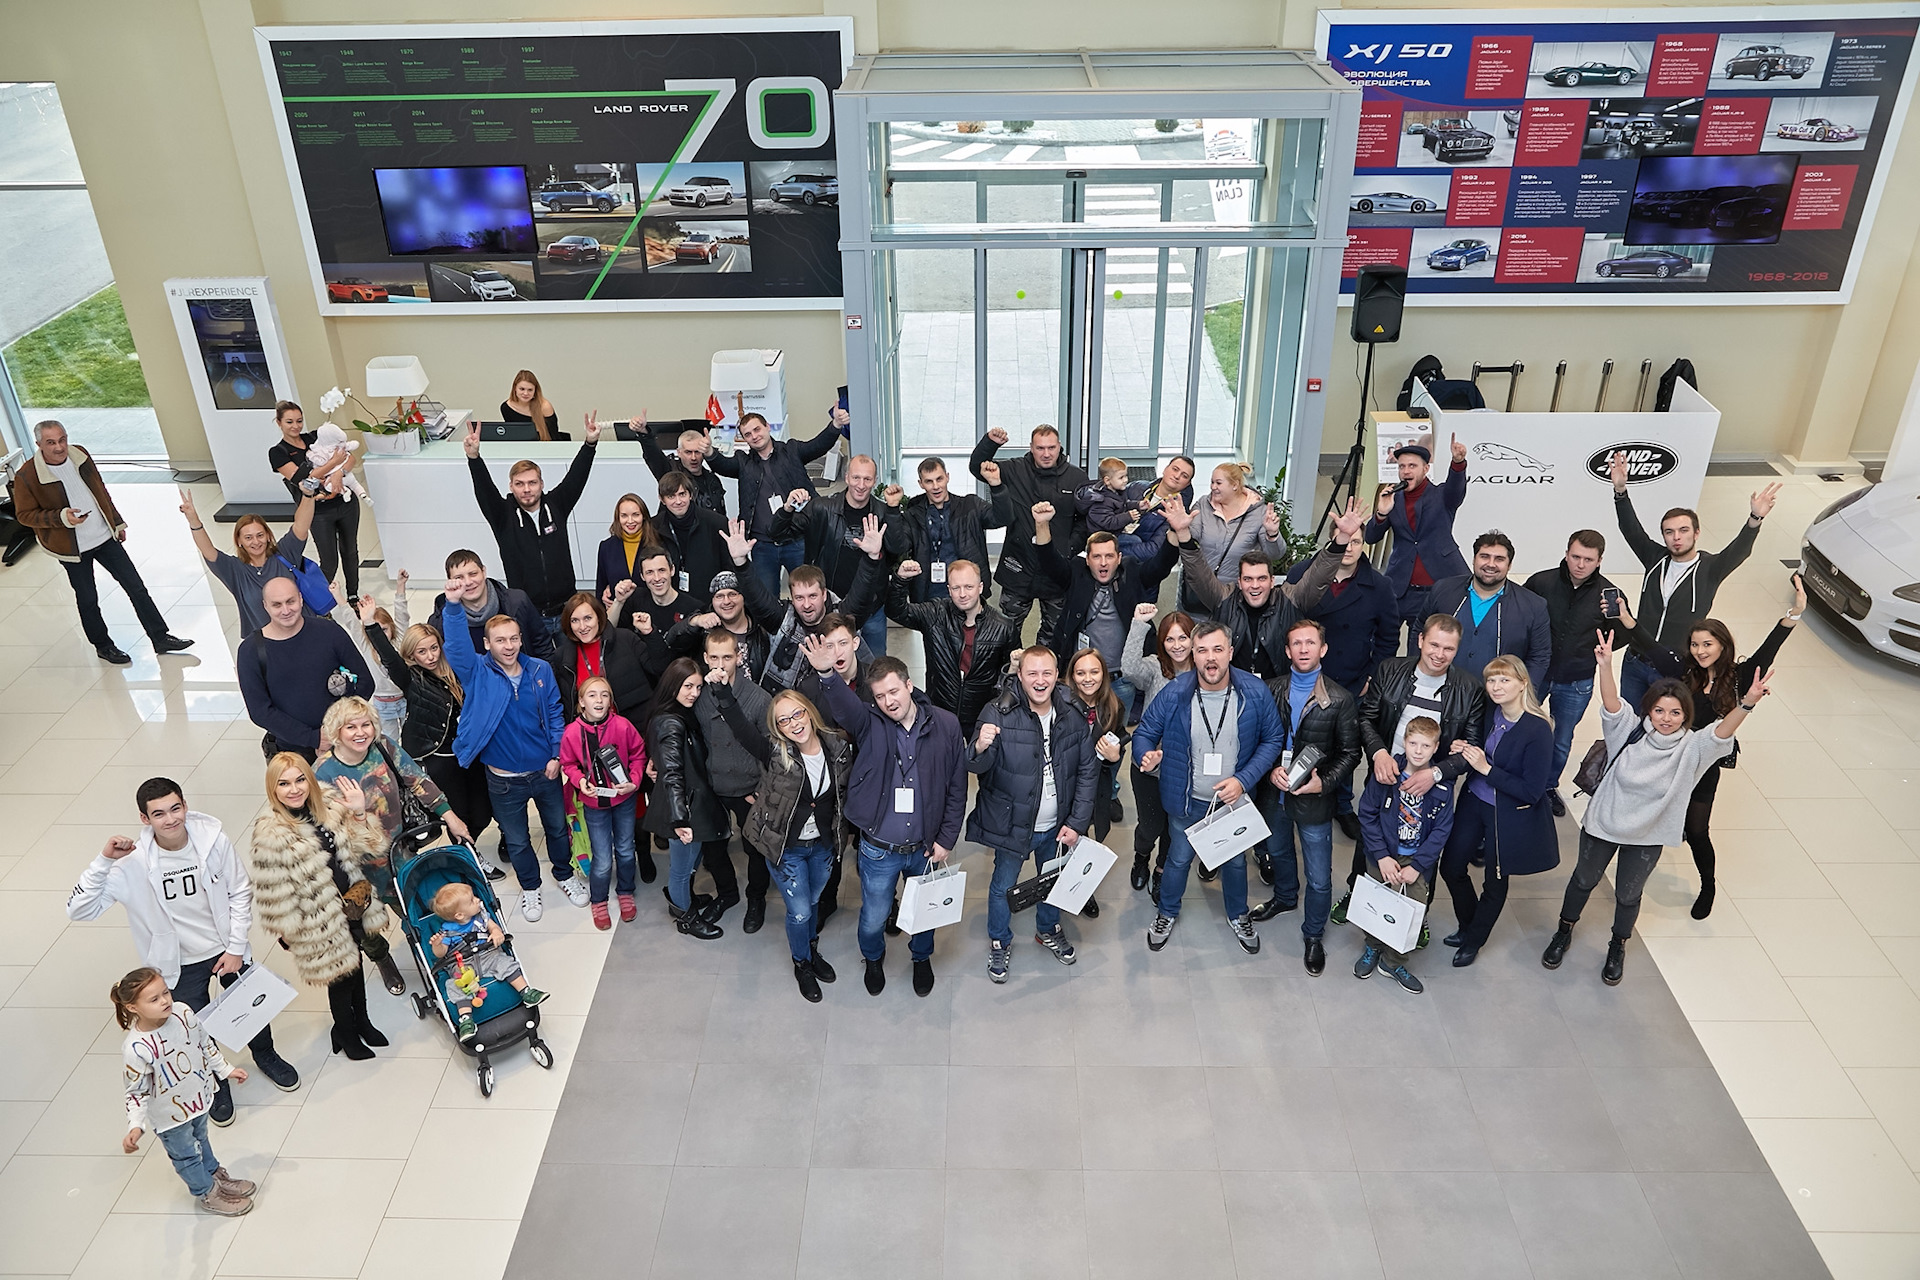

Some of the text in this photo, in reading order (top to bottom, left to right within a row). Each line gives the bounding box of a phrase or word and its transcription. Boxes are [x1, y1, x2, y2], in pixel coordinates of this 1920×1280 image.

[1343, 44, 1453, 64] XJ 50
[1343, 70, 1408, 79] ЭВОЛЮЦИЯ
[1350, 79, 1431, 87] ОВЕРШЕНСТВА
[593, 104, 689, 113] LAND ROVER
[664, 77, 830, 162] 70
[1748, 272, 1829, 282] 1968-2018
[1811, 573, 1836, 598] JAGUAR
